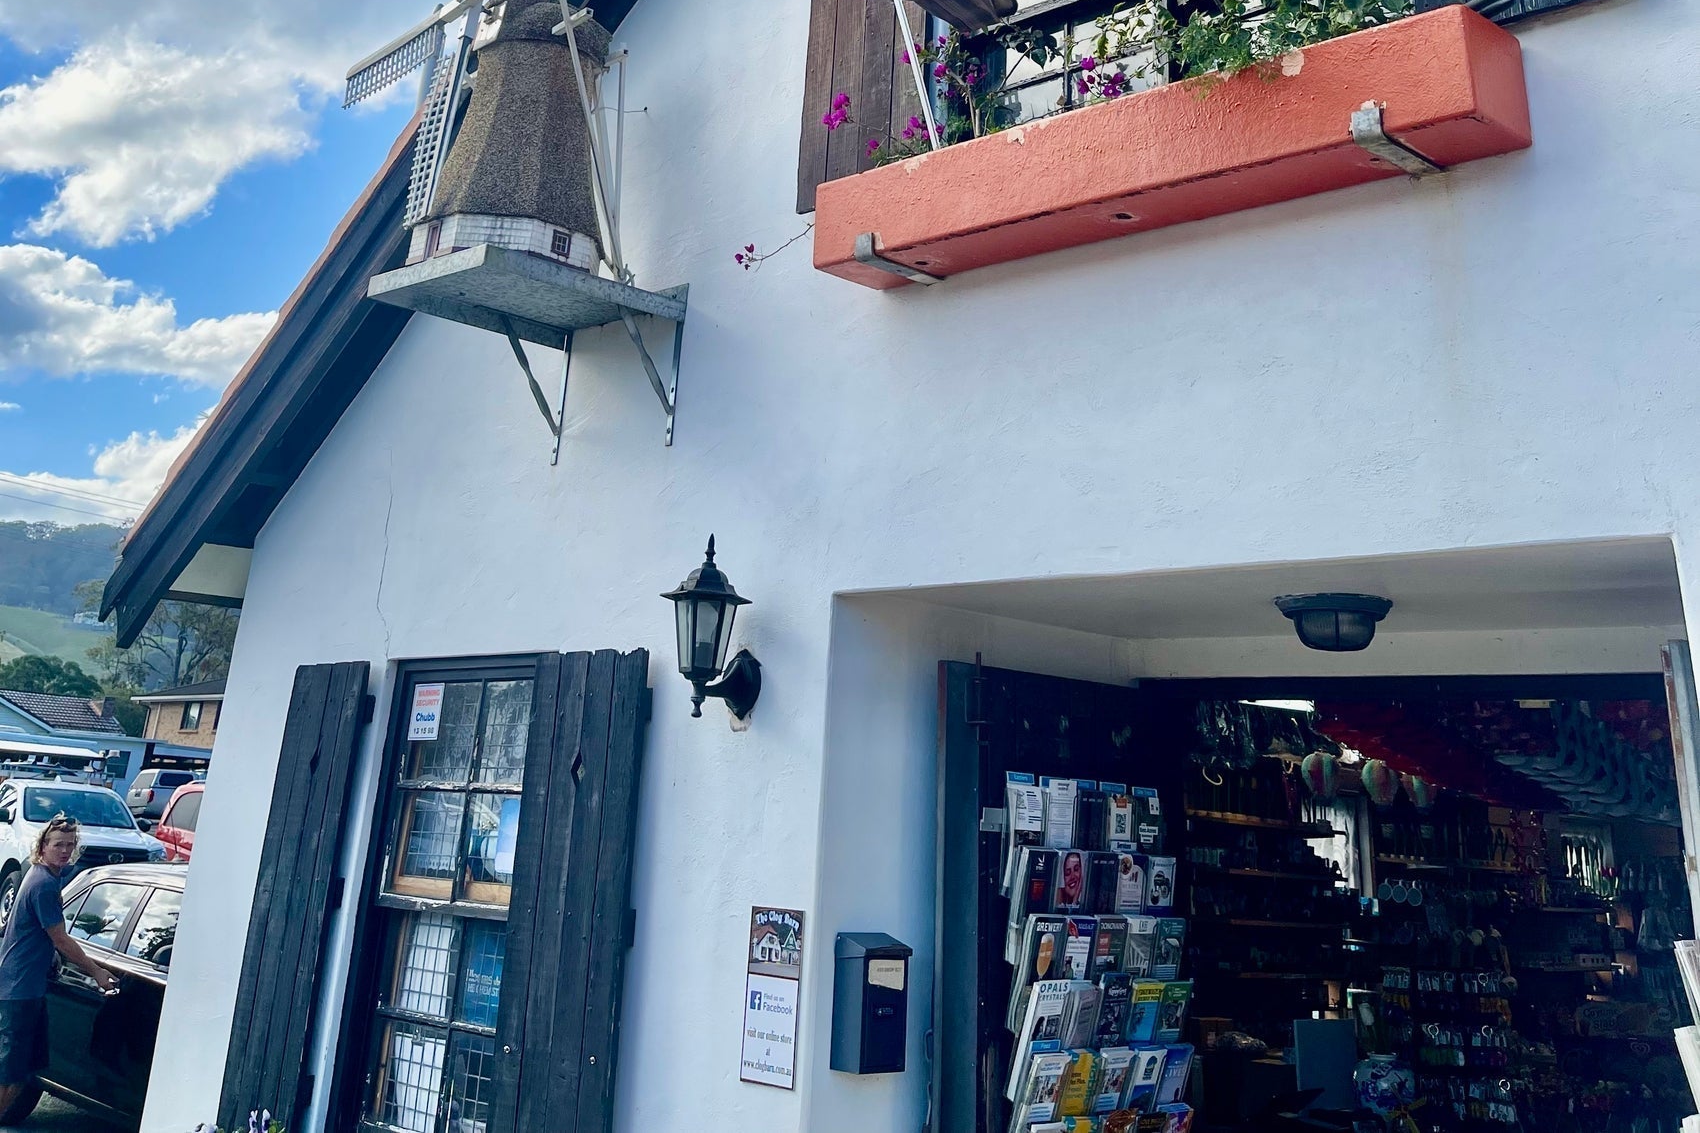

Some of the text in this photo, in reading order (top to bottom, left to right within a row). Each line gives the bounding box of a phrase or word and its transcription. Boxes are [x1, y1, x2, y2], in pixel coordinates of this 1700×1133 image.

[416, 698, 440, 707] SECURITY
[416, 712, 436, 722] Chubb
[756, 910, 800, 932] The Clog Barn
[1040, 981, 1069, 994] OPALS
[763, 1001, 793, 1015] Facebook
[766, 1029, 780, 1042] online
[780, 1034, 792, 1045] store
